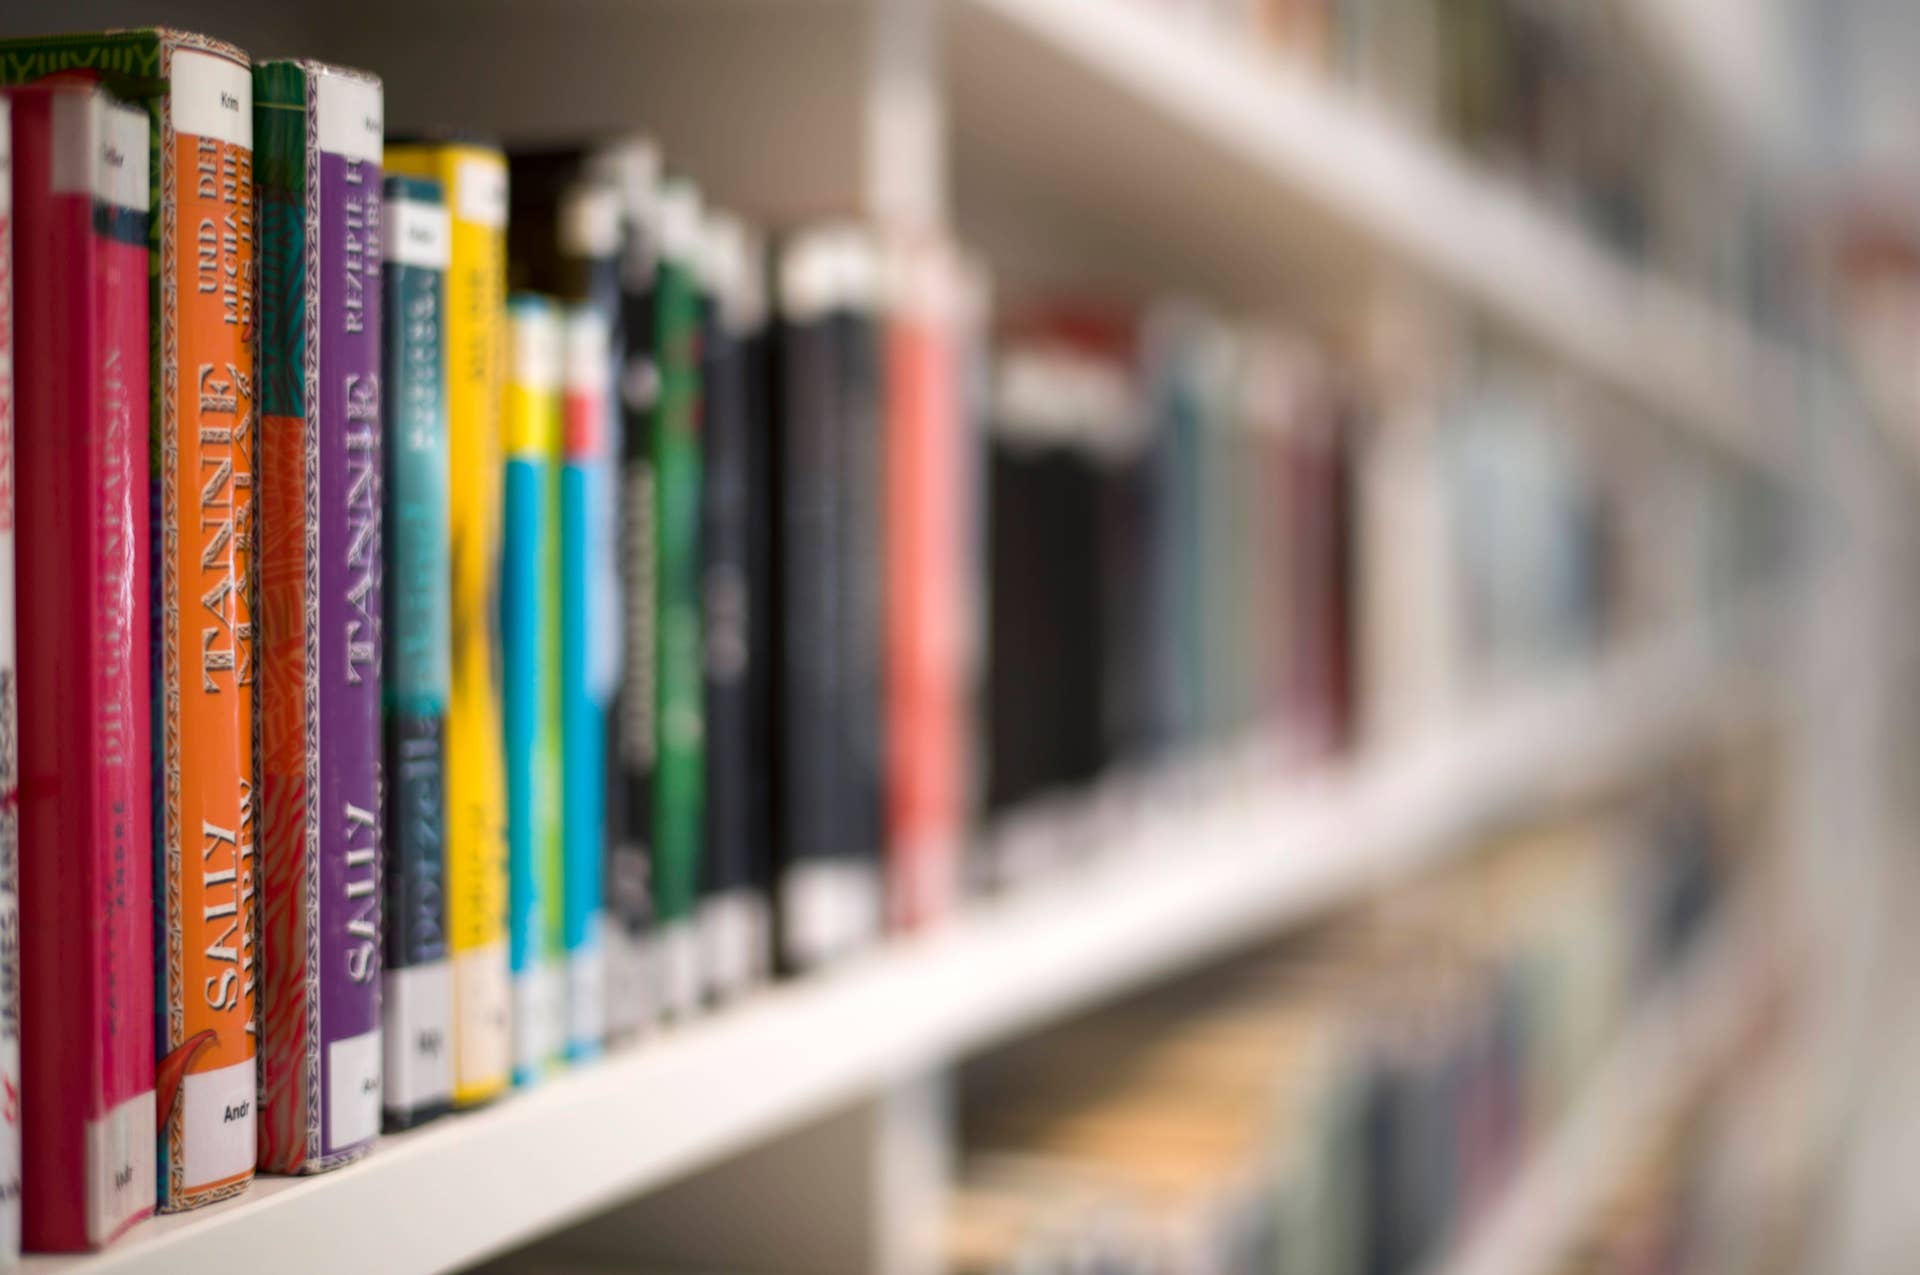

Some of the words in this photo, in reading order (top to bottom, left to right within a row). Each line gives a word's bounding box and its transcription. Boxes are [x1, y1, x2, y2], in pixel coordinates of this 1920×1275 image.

[197, 217, 218, 294] UND
[346, 193, 364, 332] REZEPTE
[199, 362, 239, 695] TANNIE
[345, 373, 379, 685] TANNIE
[202, 817, 239, 1013] SALLY
[345, 802, 377, 984] SALLY
[223, 1101, 250, 1124] Andr
